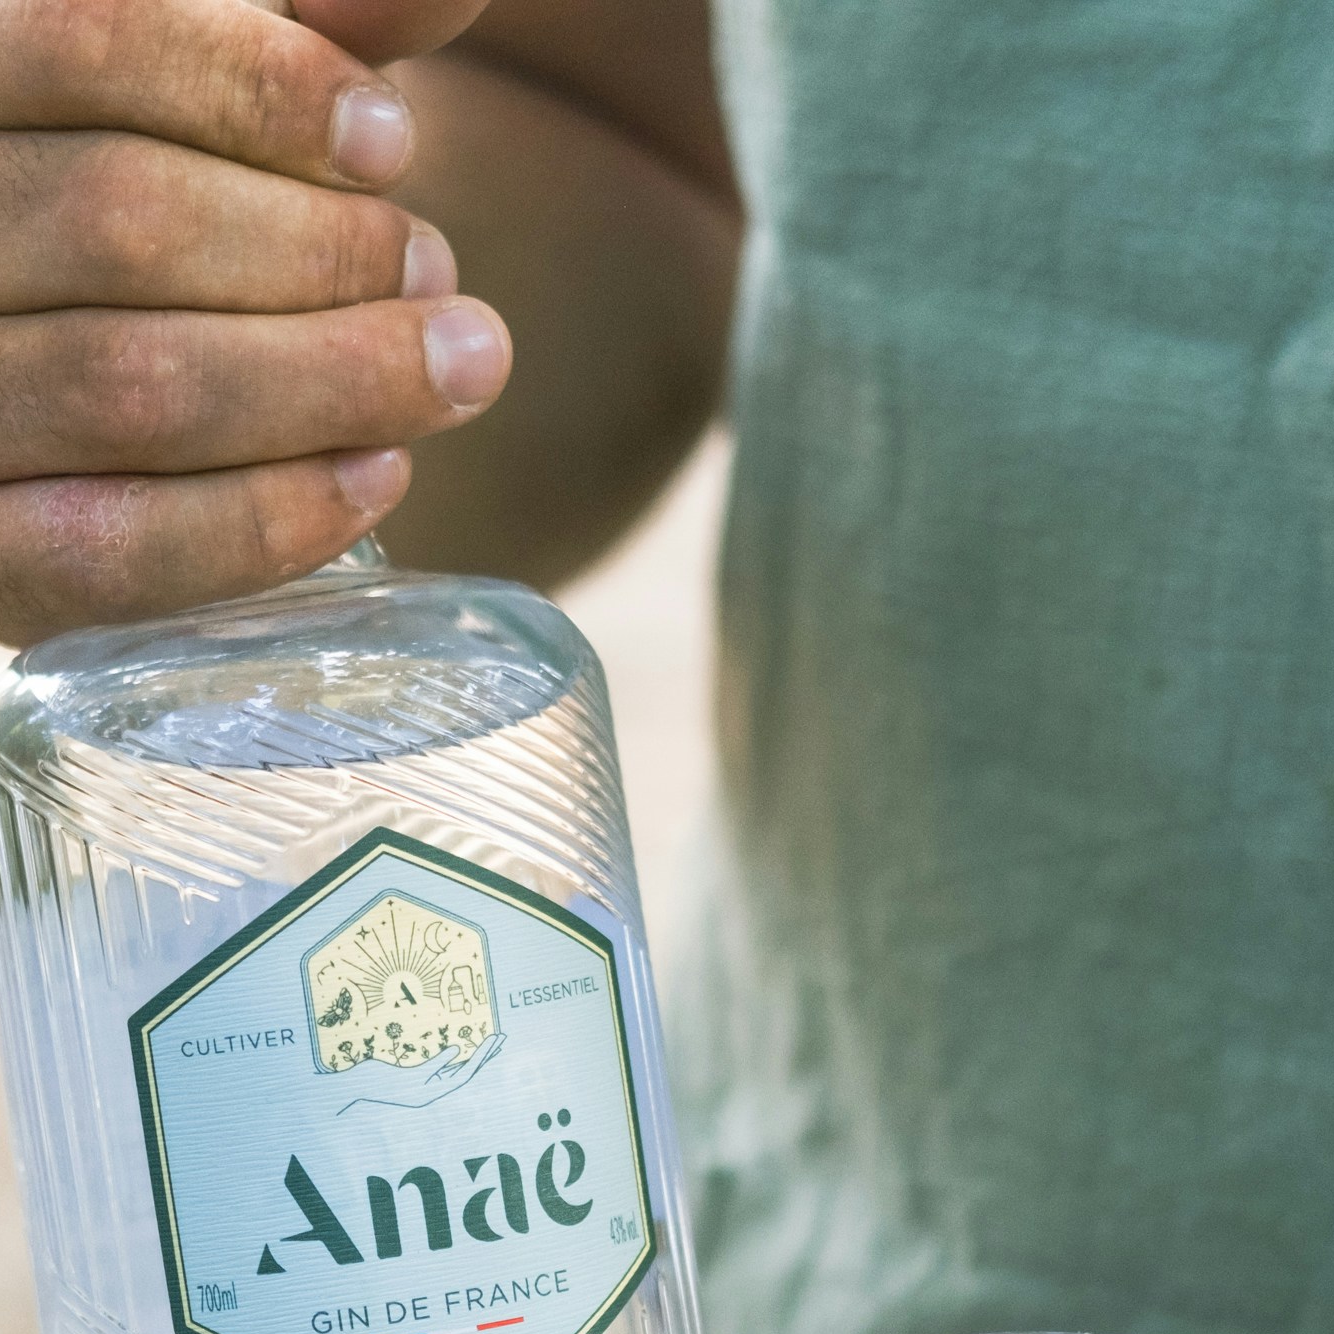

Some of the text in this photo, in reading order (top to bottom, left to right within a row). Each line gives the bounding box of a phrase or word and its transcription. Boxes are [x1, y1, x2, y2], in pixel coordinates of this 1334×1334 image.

[508, 975, 600, 1009] L'ESSENTIEL
[180, 1028, 296, 1058] CULTIVER
[256, 1108, 594, 1276] Anaë
[197, 1281, 238, 1313] 700ml
[311, 1269, 570, 1334] GIN DE FRANCE
